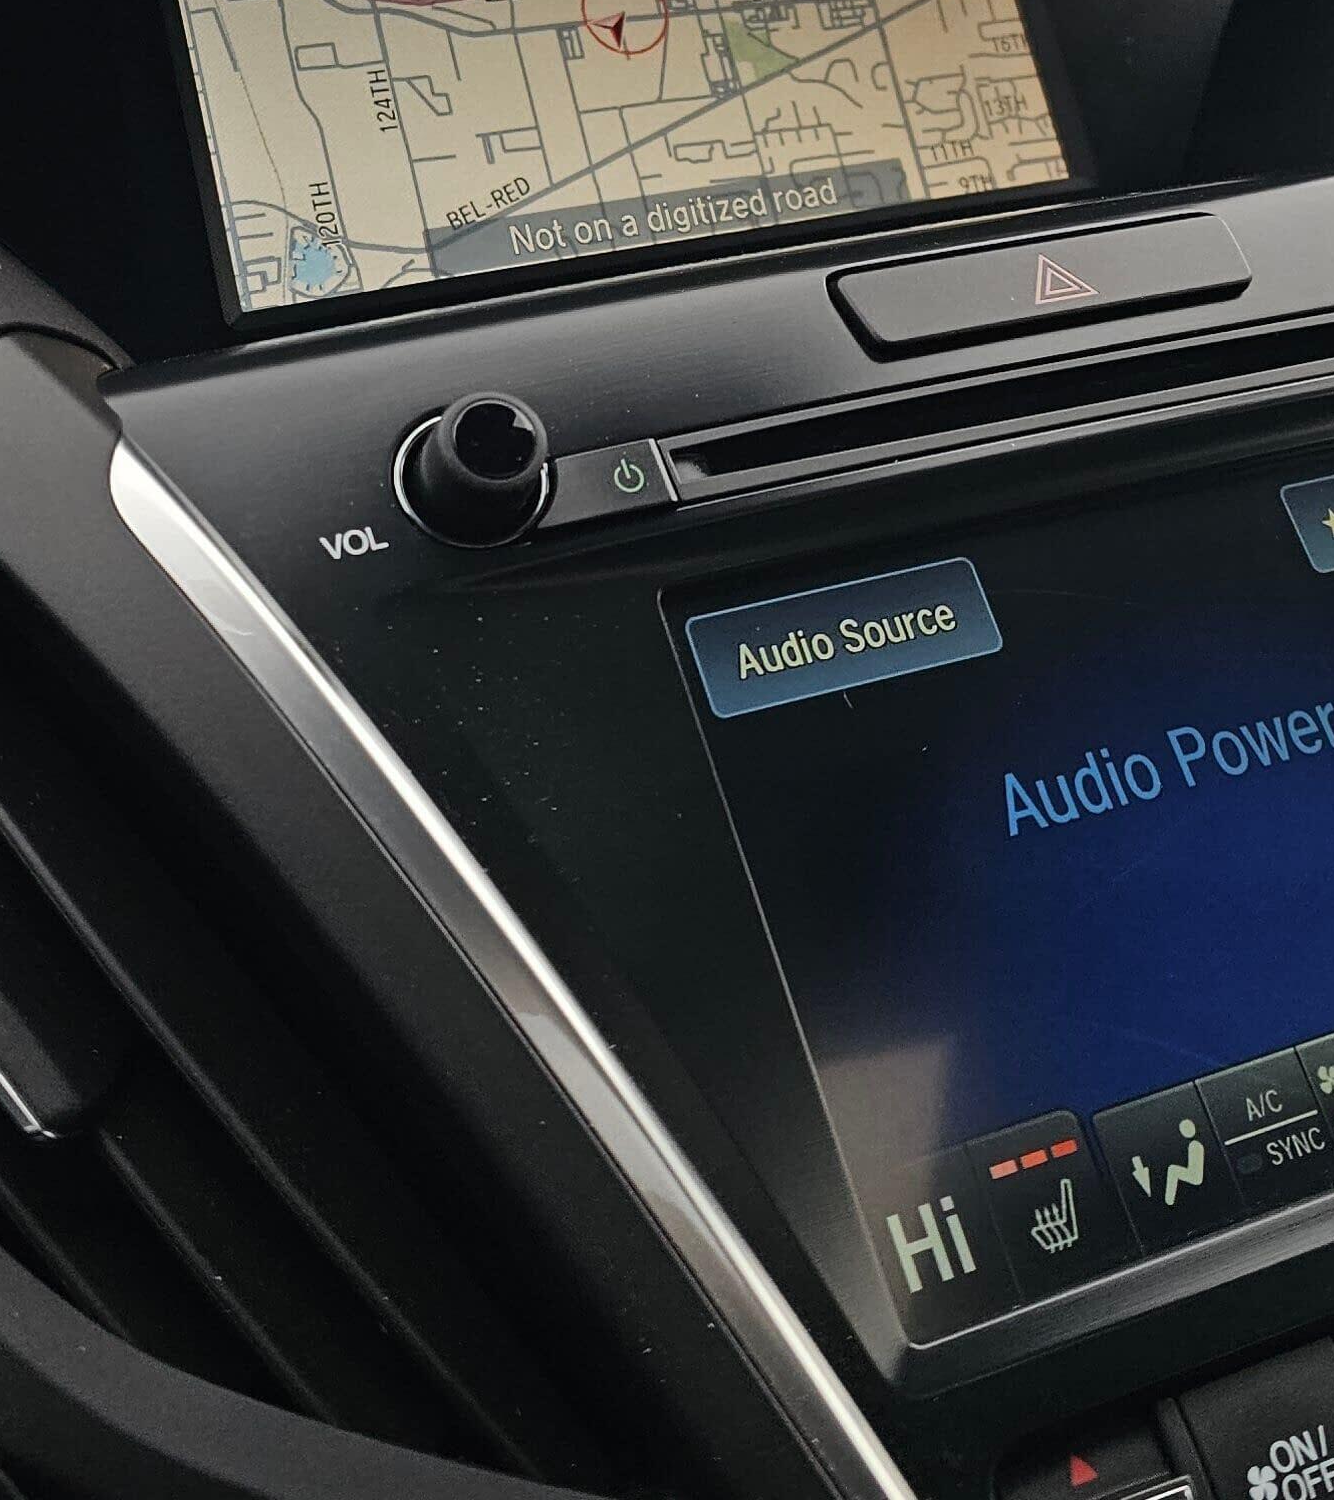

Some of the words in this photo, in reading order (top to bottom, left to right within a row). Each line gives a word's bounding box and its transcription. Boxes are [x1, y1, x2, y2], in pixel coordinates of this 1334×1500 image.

[369, 68, 399, 132] 124TH
[308, 181, 342, 248] 120TH
[446, 176, 531, 231] BEL-RED
[508, 219, 567, 255] Not
[573, 215, 613, 244] on
[621, 214, 639, 238] a
[647, 187, 767, 236] digitized
[773, 178, 838, 213] road
[319, 526, 389, 560] VOL
[737, 629, 836, 680] Audio
[839, 603, 957, 653] Source
[1002, 747, 1163, 837] Audio
[1246, 1089, 1284, 1123] A/C
[1266, 1127, 1327, 1167] SYNC
[885, 1195, 977, 1294] Hi
